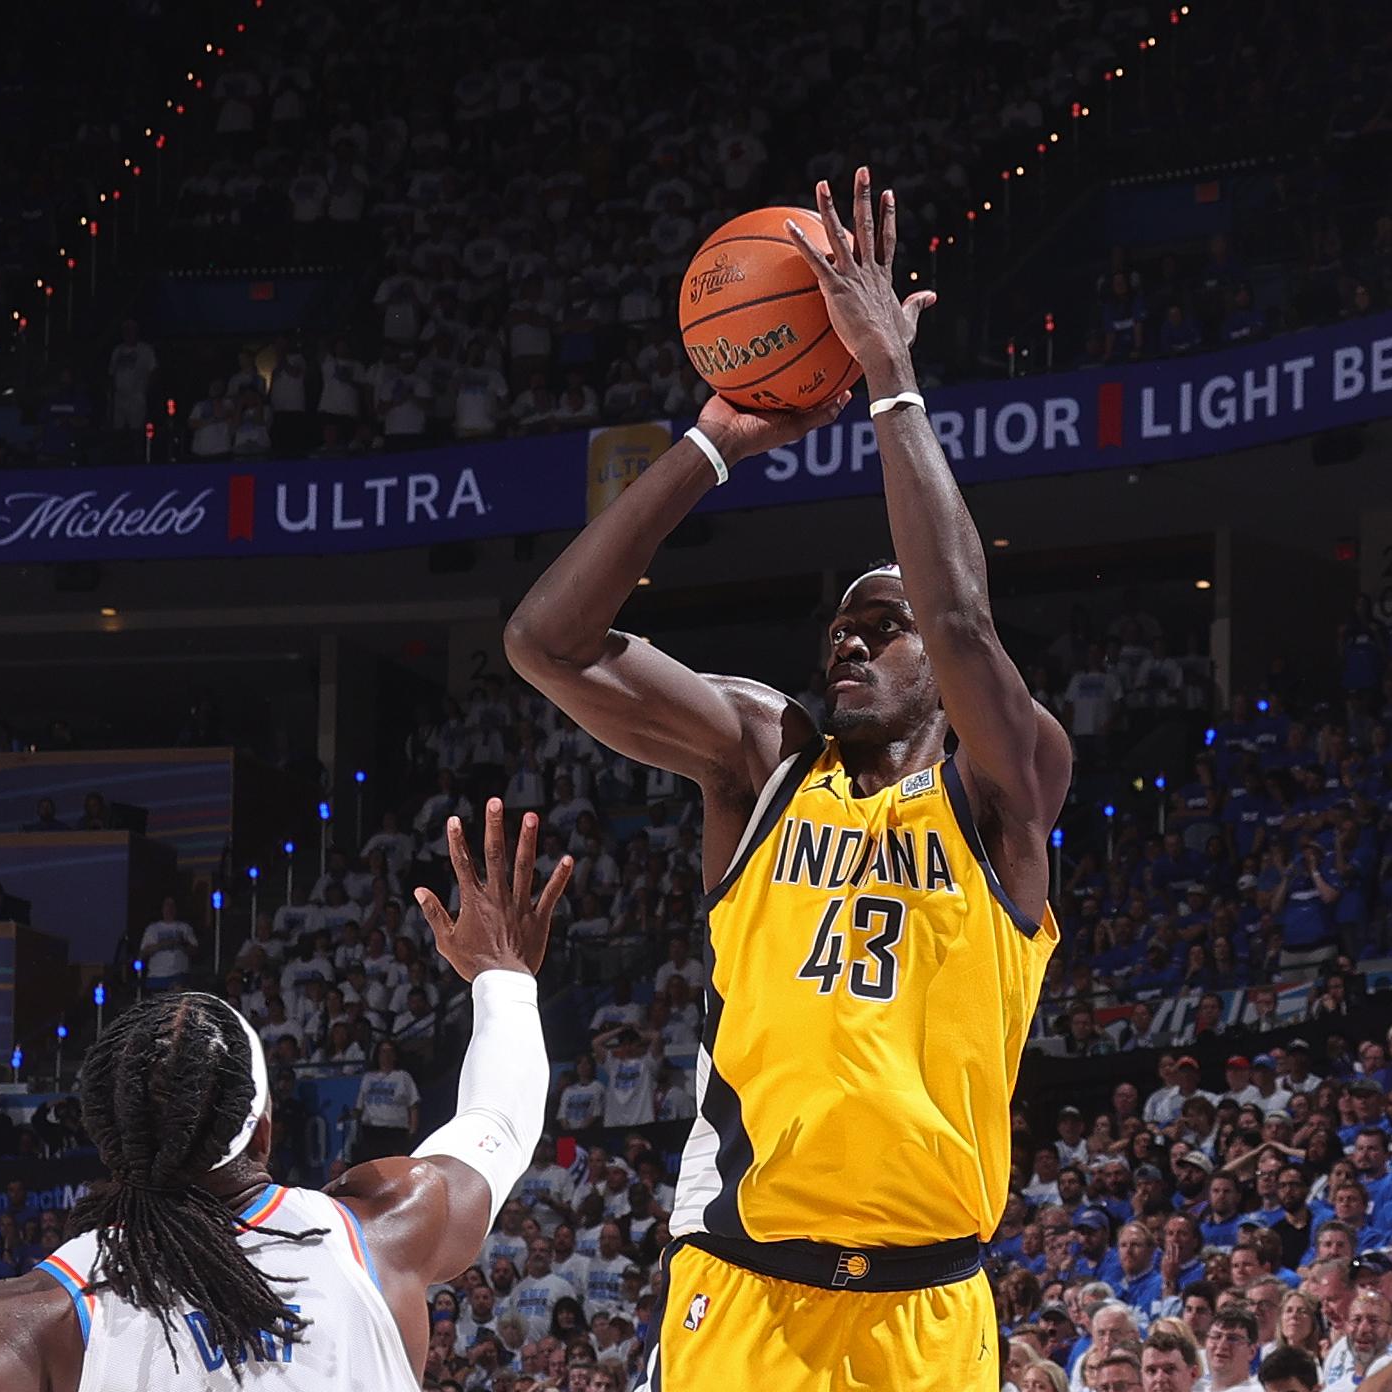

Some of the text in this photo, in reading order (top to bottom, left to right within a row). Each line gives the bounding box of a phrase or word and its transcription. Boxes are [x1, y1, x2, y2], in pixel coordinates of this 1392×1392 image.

[687, 322, 800, 376] Wilson
[1140, 356, 1316, 440] LIGHT
[598, 457, 651, 484] ULTR
[764, 397, 1083, 483] SUPRIOR
[275, 466, 489, 533] ULTRA
[773, 816, 958, 895] INDIANA
[796, 894, 908, 1004] 43
